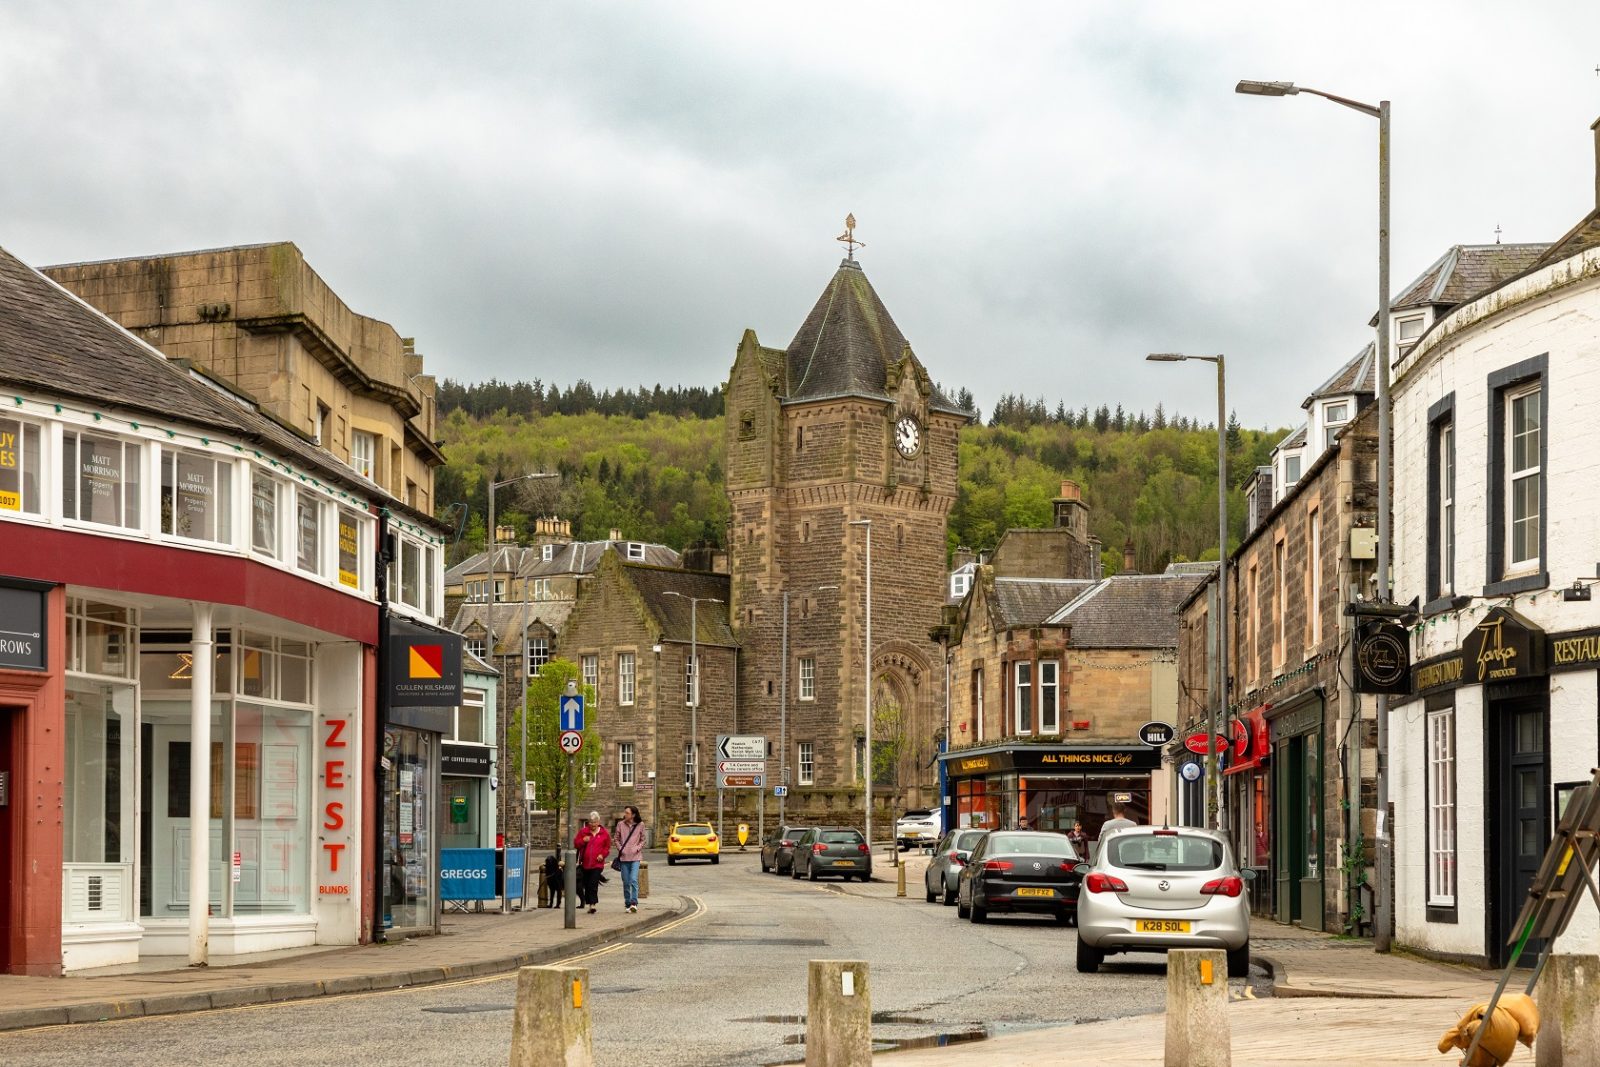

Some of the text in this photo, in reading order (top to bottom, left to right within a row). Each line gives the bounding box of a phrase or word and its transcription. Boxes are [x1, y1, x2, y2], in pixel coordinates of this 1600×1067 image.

[0, 450, 16, 467] ES
[91, 454, 111, 466] MATT
[83, 464, 119, 478] MORRISON
[187, 473, 204, 483] MATT
[89, 480, 113, 490] Property
[178, 482, 212, 495] MORRISON
[92, 488, 110, 496] Group
[184, 497, 208, 508] Property
[188, 504, 204, 512] Group
[0, 638, 31, 655] ROWS
[563, 737, 579, 747] 20
[1147, 733, 1166, 742] HILL
[1042, 754, 1058, 763] ALL
[1059, 754, 1091, 763] THINGS
[1092, 754, 1112, 763] NICE
[323, 720, 346, 872] ZEST
[440, 869, 487, 879] GREGGS
[319, 886, 348, 894] BLINDS
[1143, 922, 1183, 931] K28 SOL
